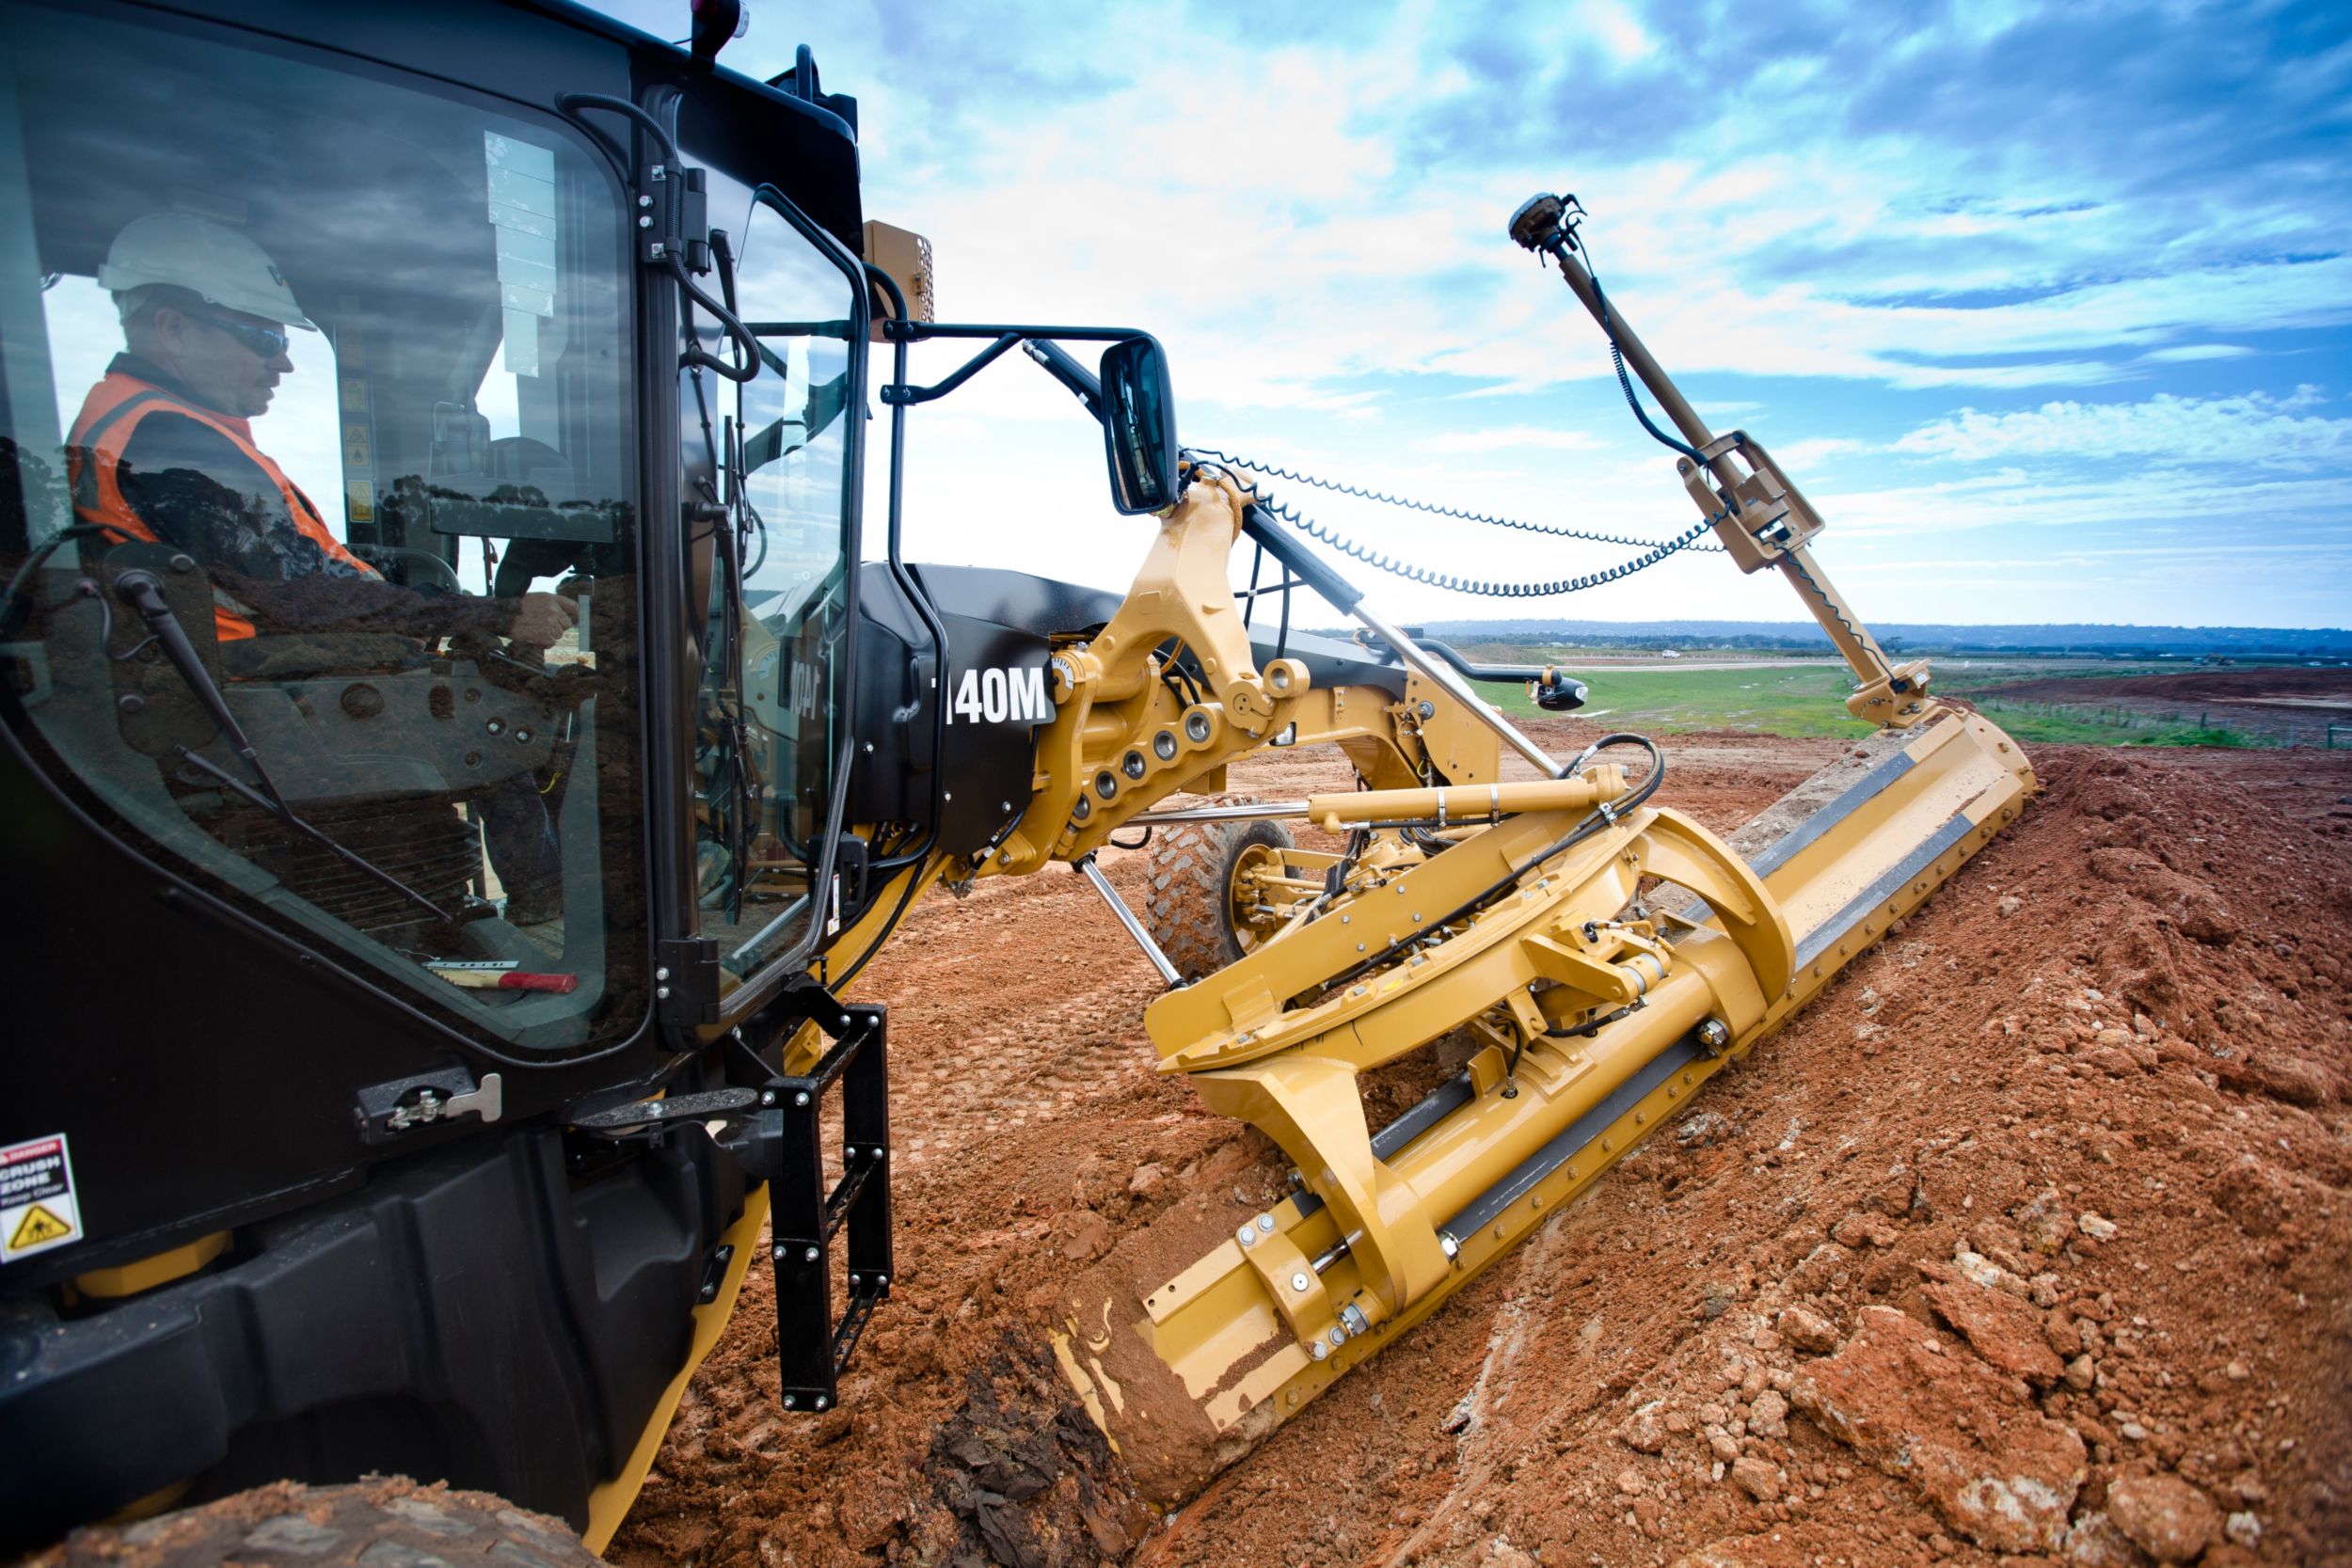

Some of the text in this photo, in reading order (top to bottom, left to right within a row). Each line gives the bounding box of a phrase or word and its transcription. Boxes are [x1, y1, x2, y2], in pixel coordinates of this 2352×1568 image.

[9, 1142, 57, 1160] DANGER
[0, 1155, 61, 1180] CRUSH
[0, 1172, 51, 1196] ZONE
[33, 1183, 63, 1197] Clear
